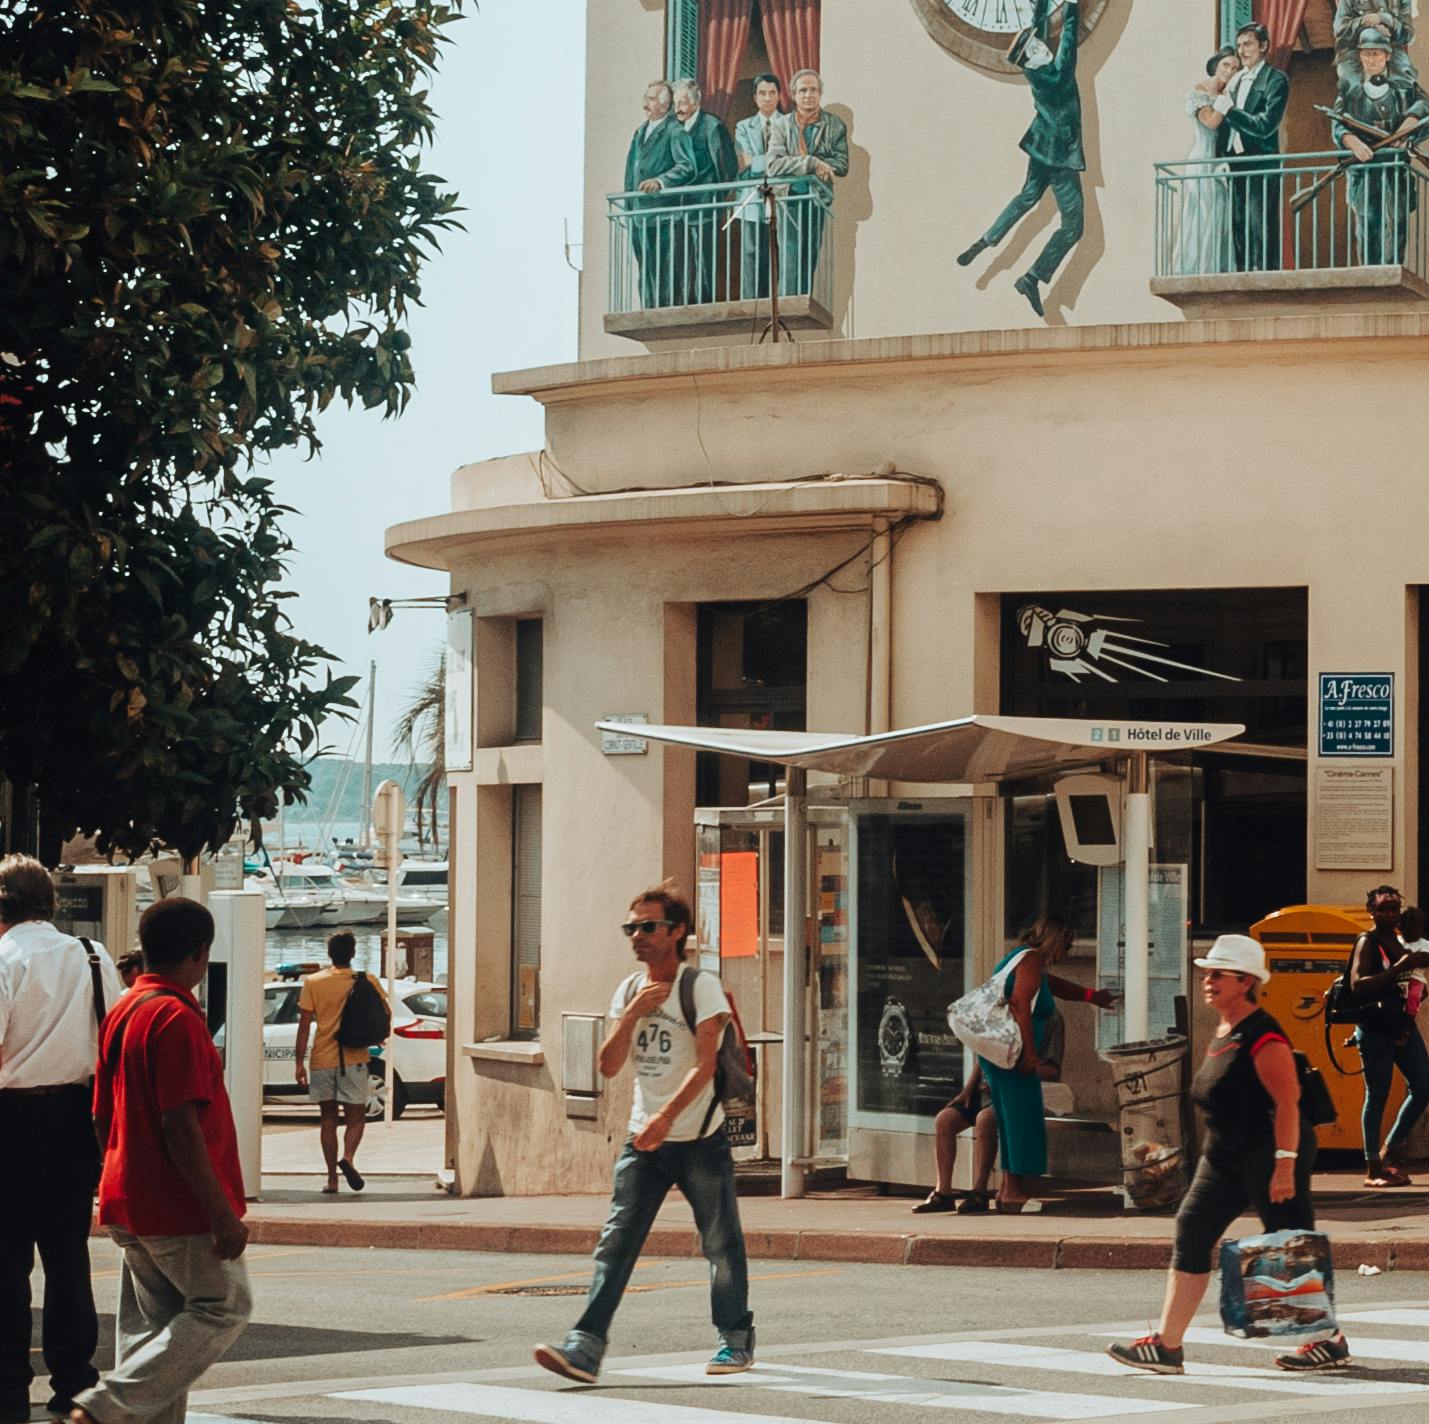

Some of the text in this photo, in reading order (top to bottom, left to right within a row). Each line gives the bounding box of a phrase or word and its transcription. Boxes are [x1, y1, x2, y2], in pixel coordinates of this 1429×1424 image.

[1127, 728, 1162, 741] Hôtel
[1164, 728, 1181, 741] de
[1183, 728, 1212, 741] Ville
